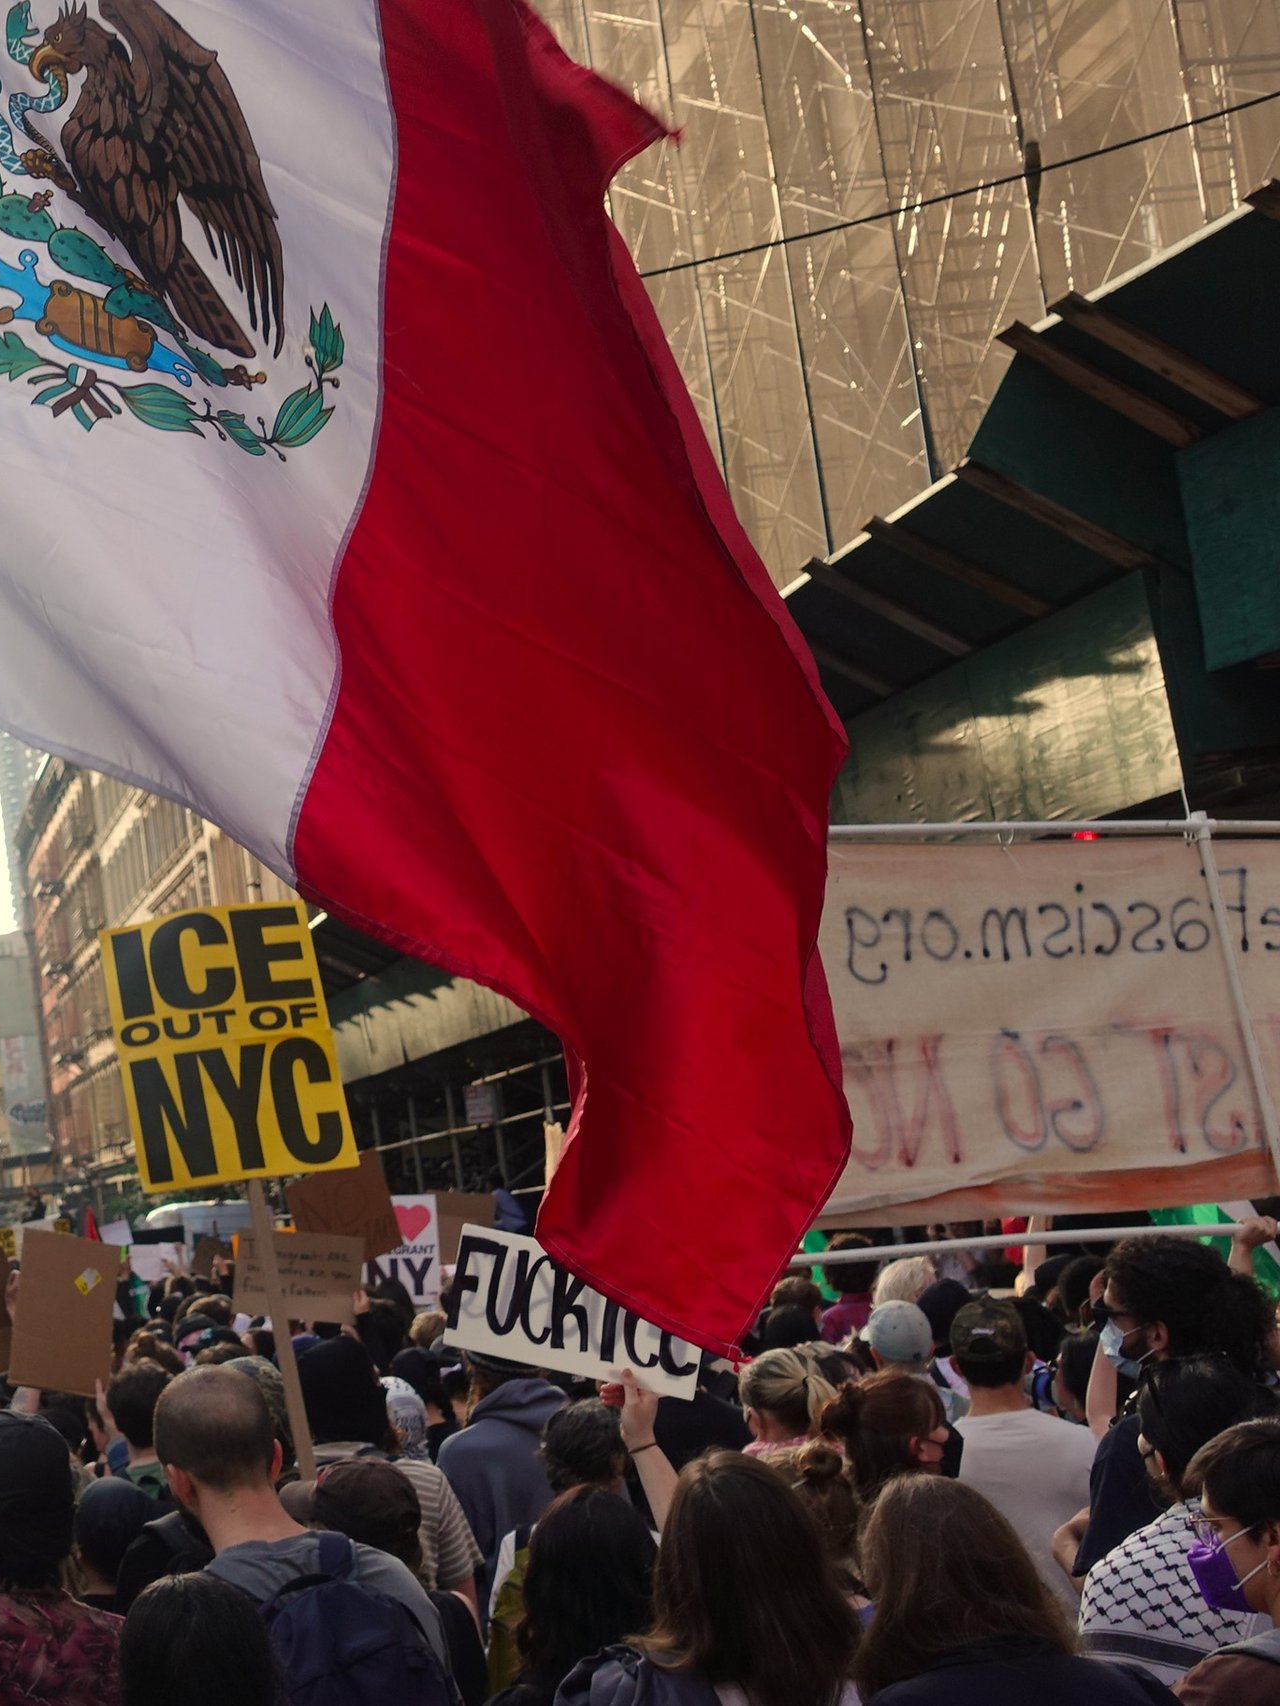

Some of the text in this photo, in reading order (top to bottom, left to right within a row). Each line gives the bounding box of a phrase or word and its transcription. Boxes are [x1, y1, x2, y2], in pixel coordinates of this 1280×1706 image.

[111, 906, 315, 1020] ICE
[120, 1002, 318, 1047] OUT OF
[129, 1037, 343, 1185] NYC
[367, 1257, 434, 1296] NY
[389, 1244, 435, 1255] GRANT
[446, 1235, 589, 1353] FUCK
